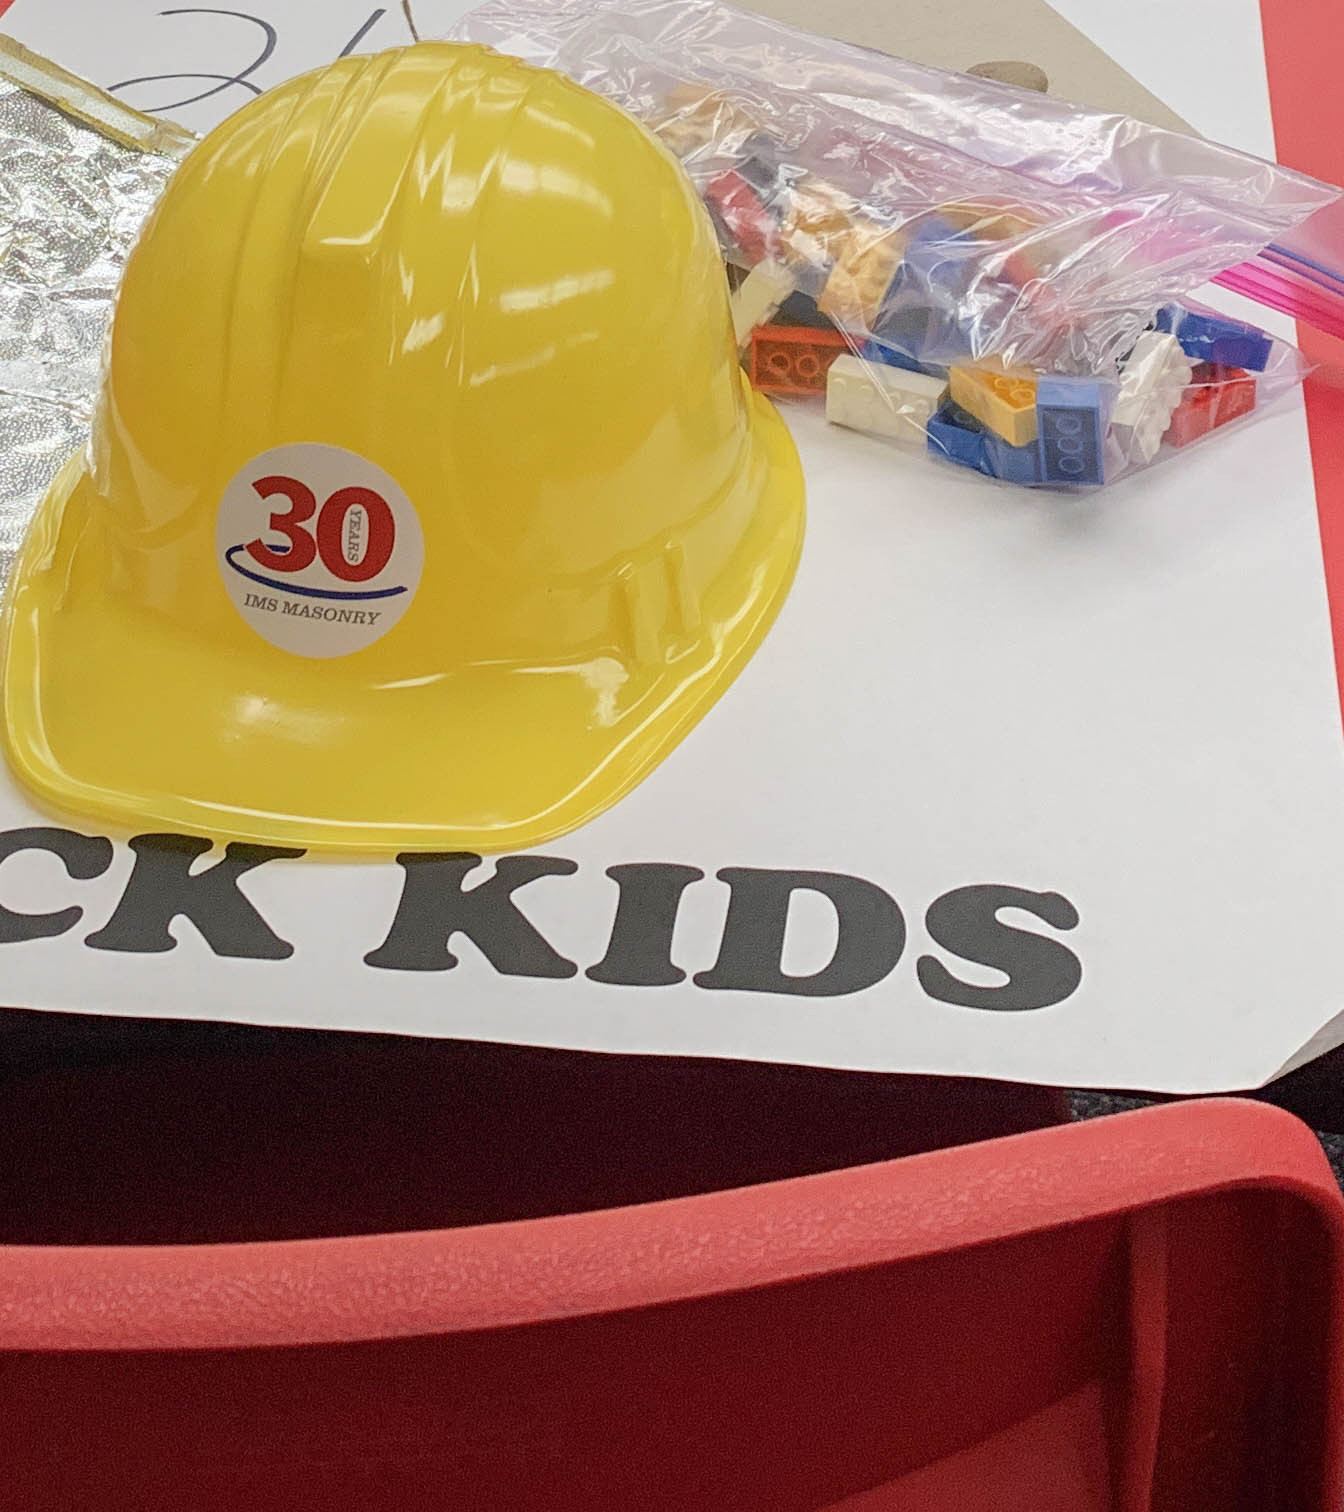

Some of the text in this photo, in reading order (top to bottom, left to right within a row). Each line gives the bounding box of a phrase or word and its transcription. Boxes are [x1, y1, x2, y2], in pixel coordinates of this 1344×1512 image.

[245, 475, 396, 583] 30
[347, 509, 363, 563] YEARS
[243, 593, 382, 626] IMS MASONRY
[362, 851, 1083, 1013] KIDS
